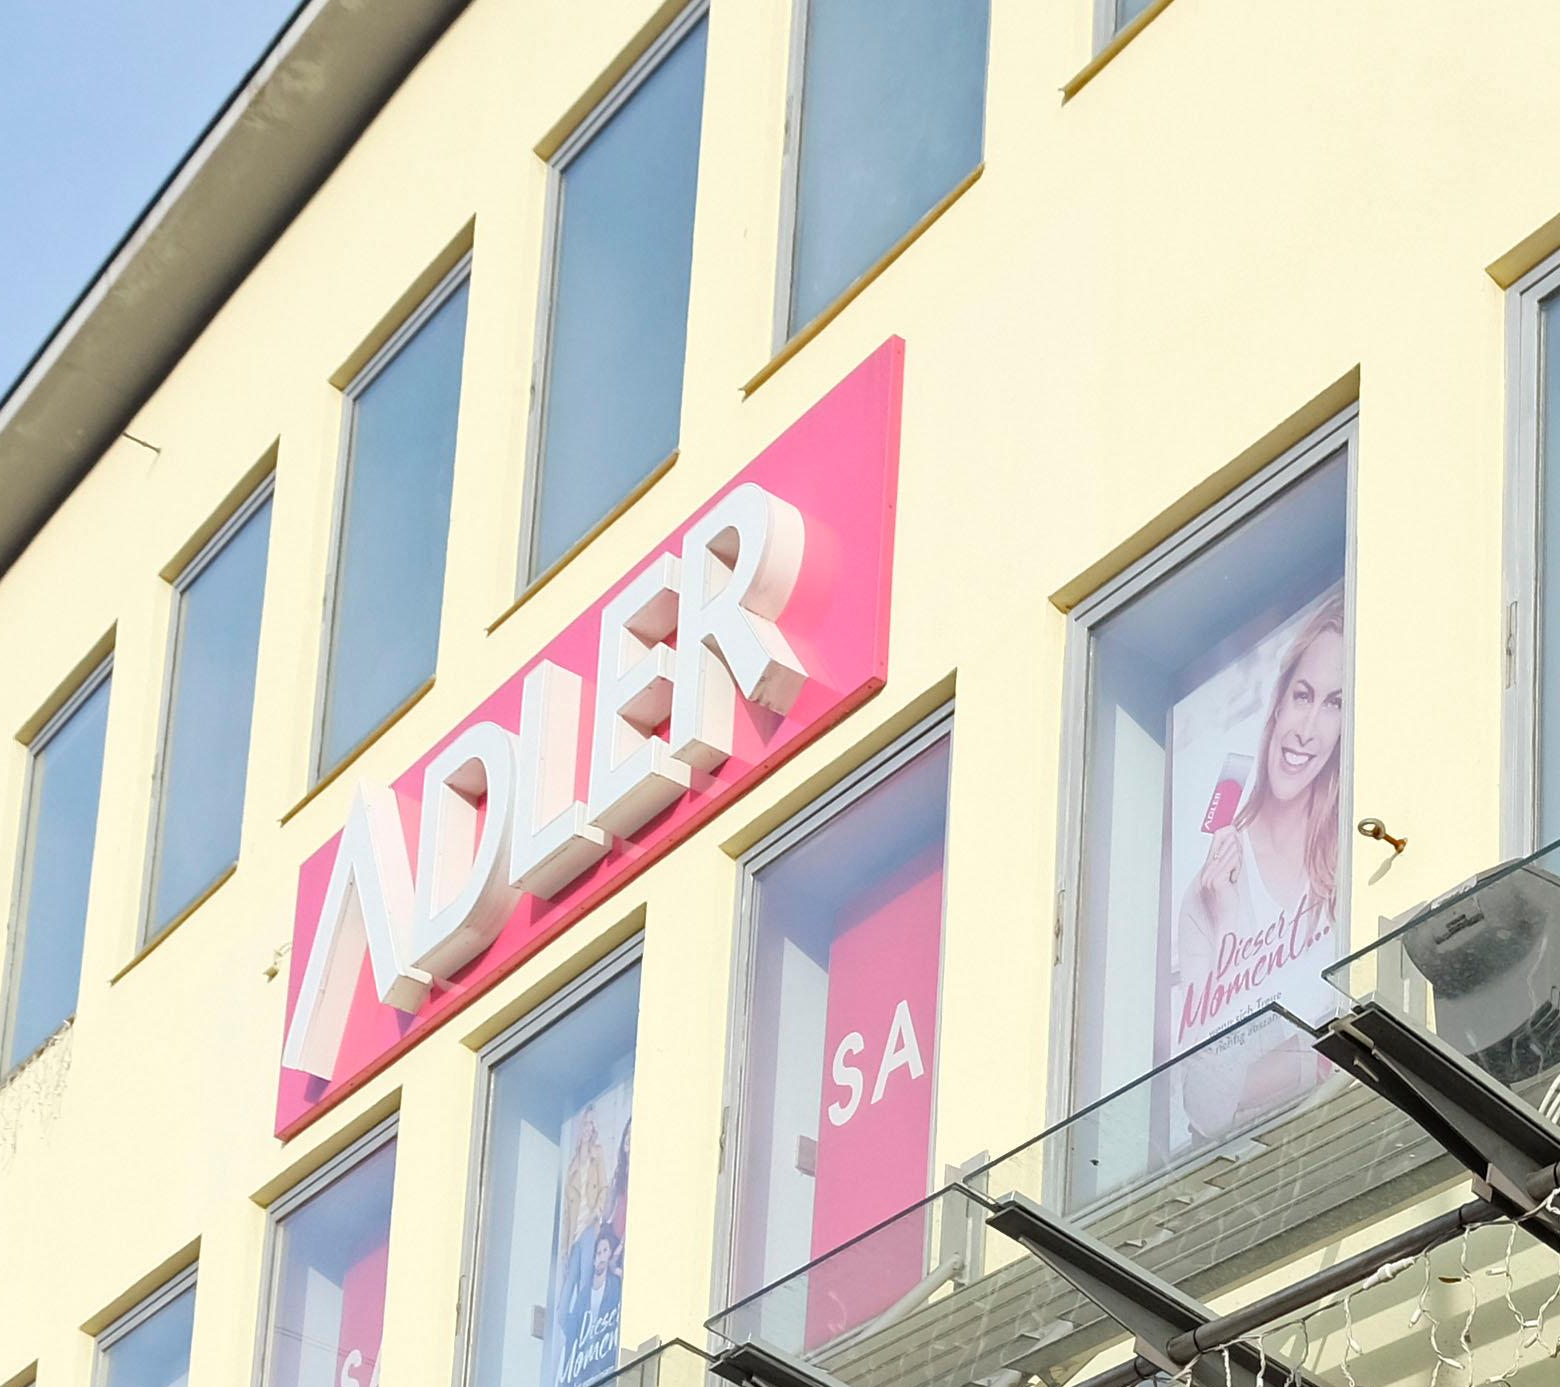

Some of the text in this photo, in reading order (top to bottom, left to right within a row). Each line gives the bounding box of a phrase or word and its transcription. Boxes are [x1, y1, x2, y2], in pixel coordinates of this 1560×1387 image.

[280, 480, 808, 1076] ADLER
[1216, 910, 1285, 980] Dieser
[827, 998, 930, 1129] SA
